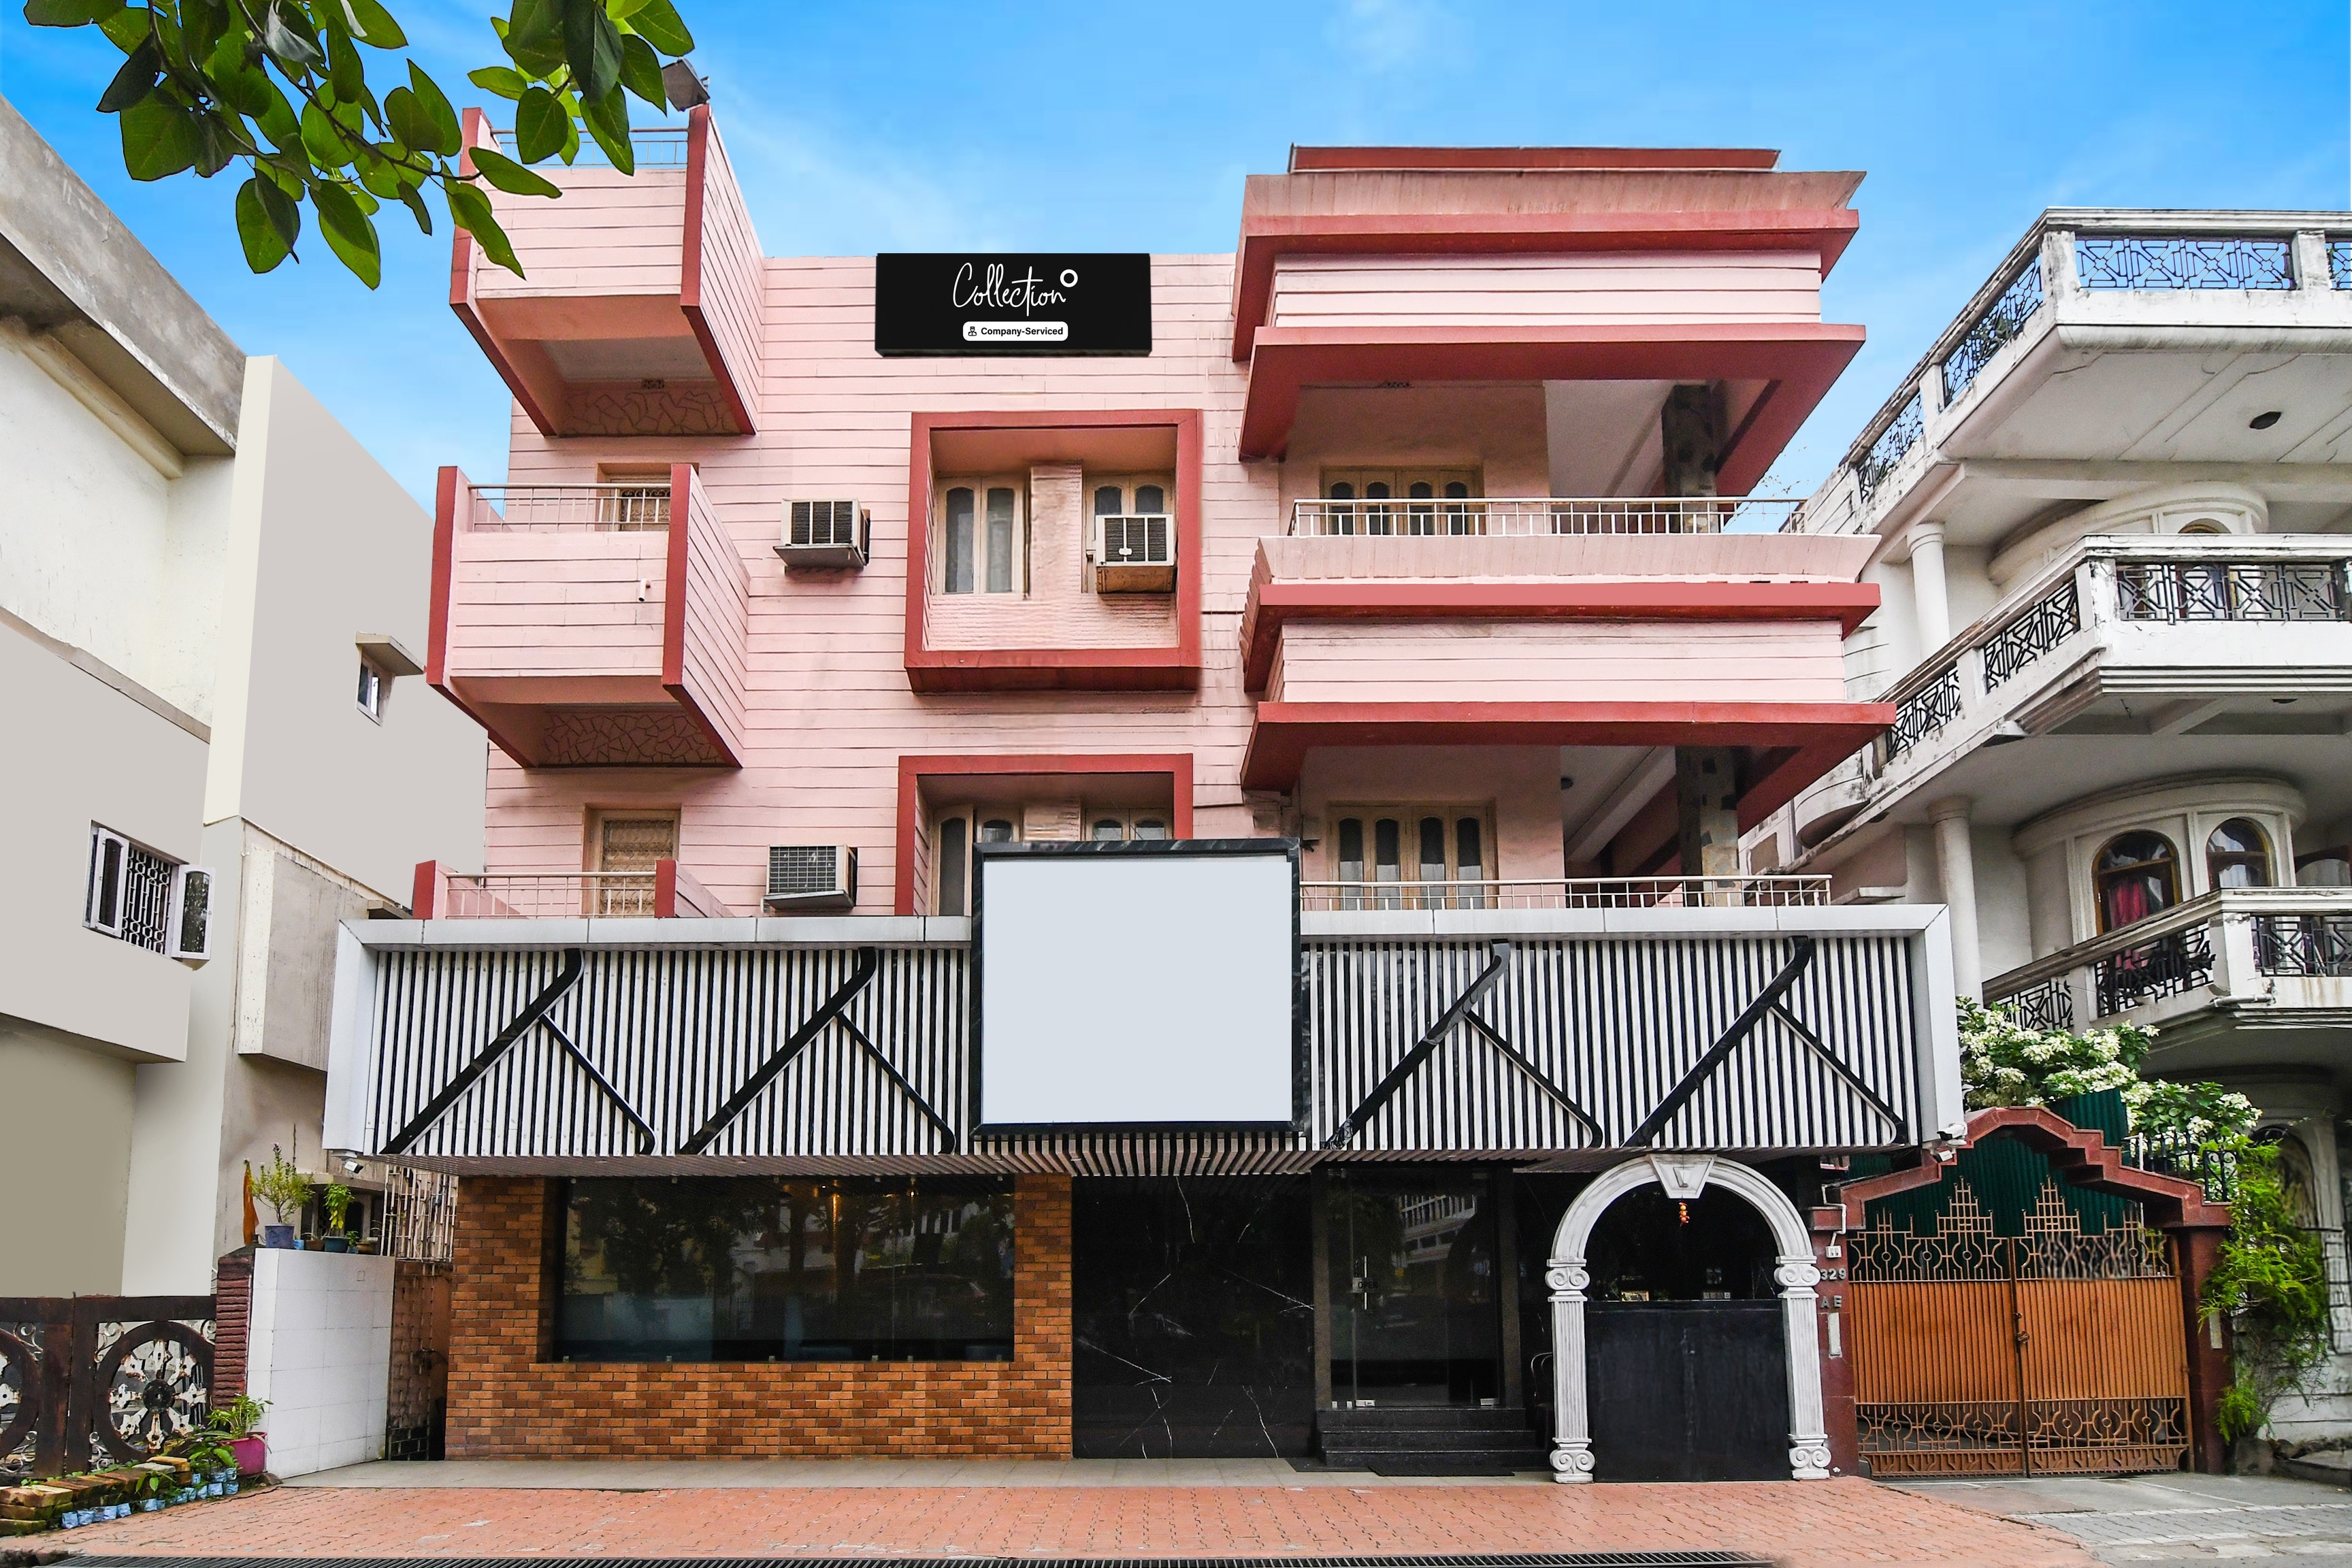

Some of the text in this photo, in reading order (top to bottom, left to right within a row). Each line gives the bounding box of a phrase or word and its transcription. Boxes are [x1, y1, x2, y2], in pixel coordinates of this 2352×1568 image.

[953, 262, 1066, 316] Collection
[981, 327, 1063, 337] Company-Serviced
[1820, 1268, 1847, 1280] 329
